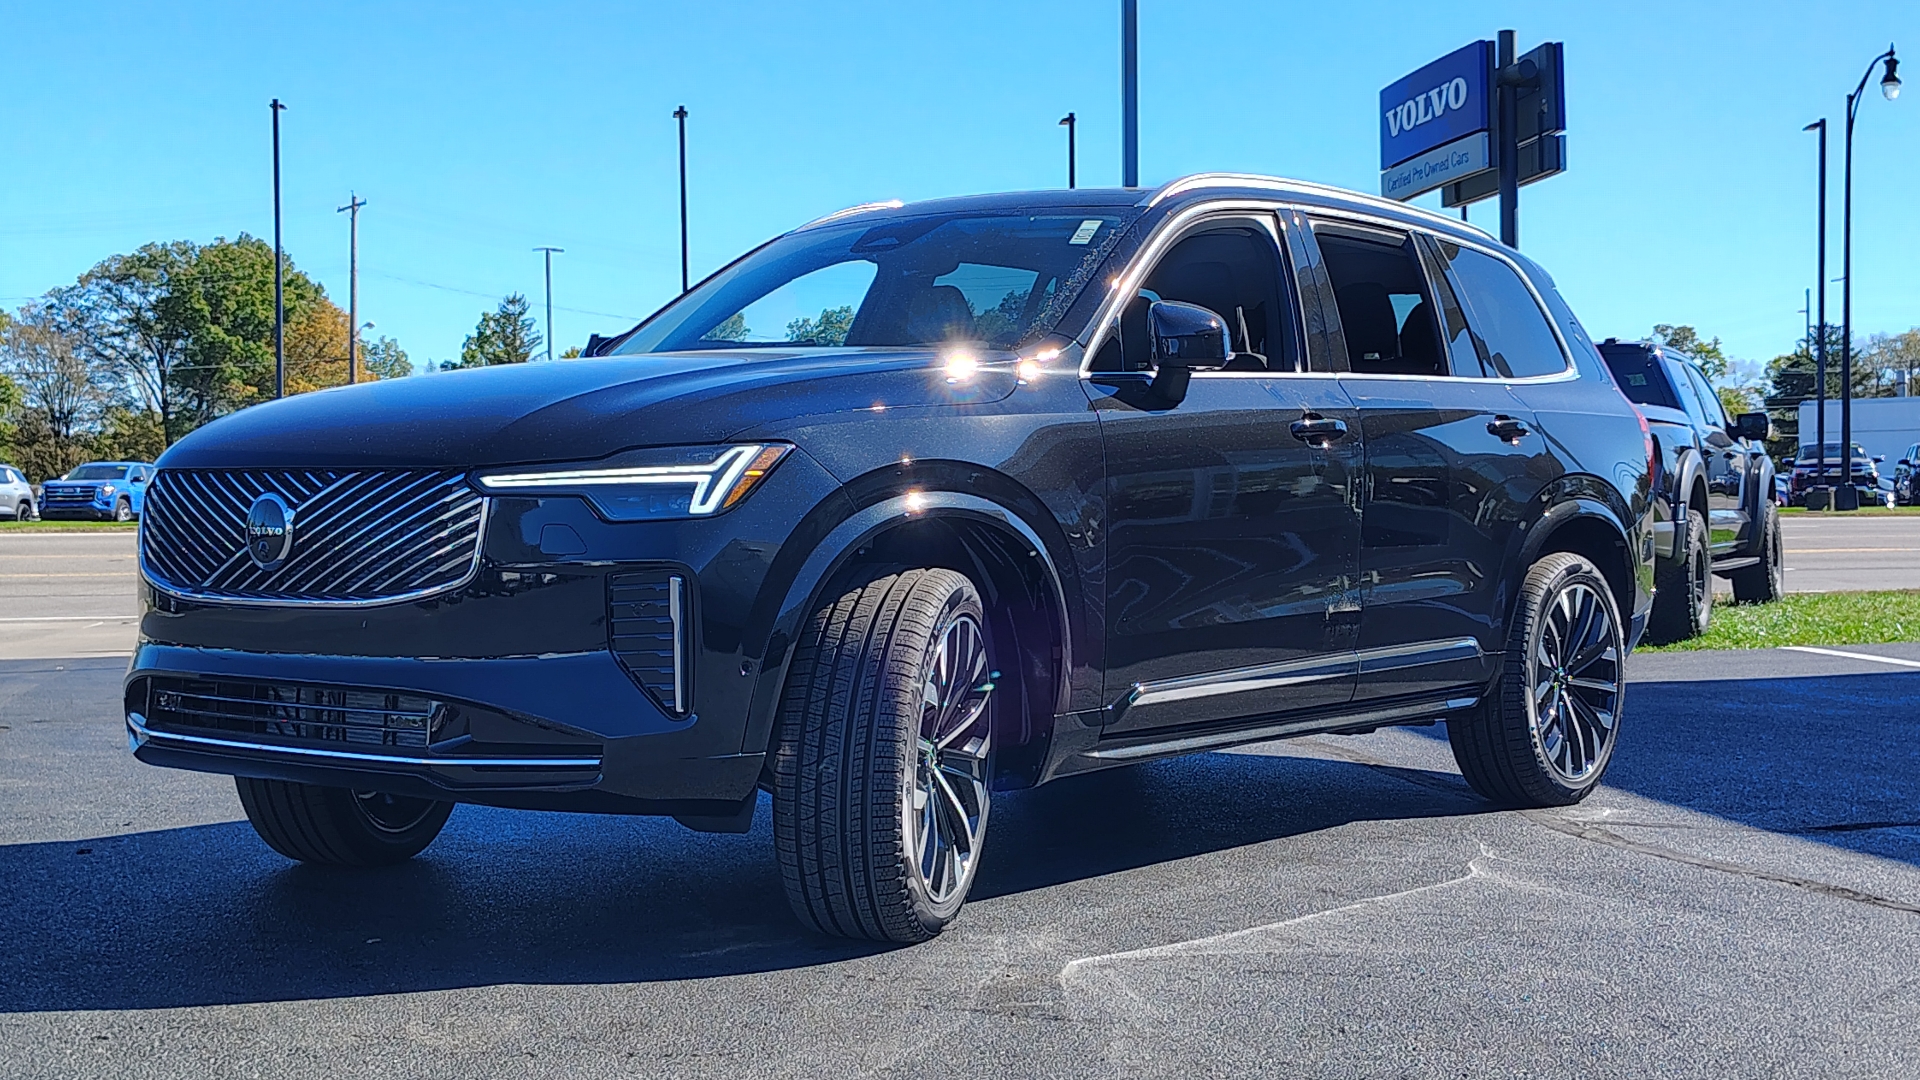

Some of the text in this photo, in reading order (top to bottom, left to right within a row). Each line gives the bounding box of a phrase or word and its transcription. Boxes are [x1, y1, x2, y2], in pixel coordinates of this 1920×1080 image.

[1386, 77, 1467, 137] VOLVO
[1388, 151, 1469, 192] Certified Pre Owned Cars
